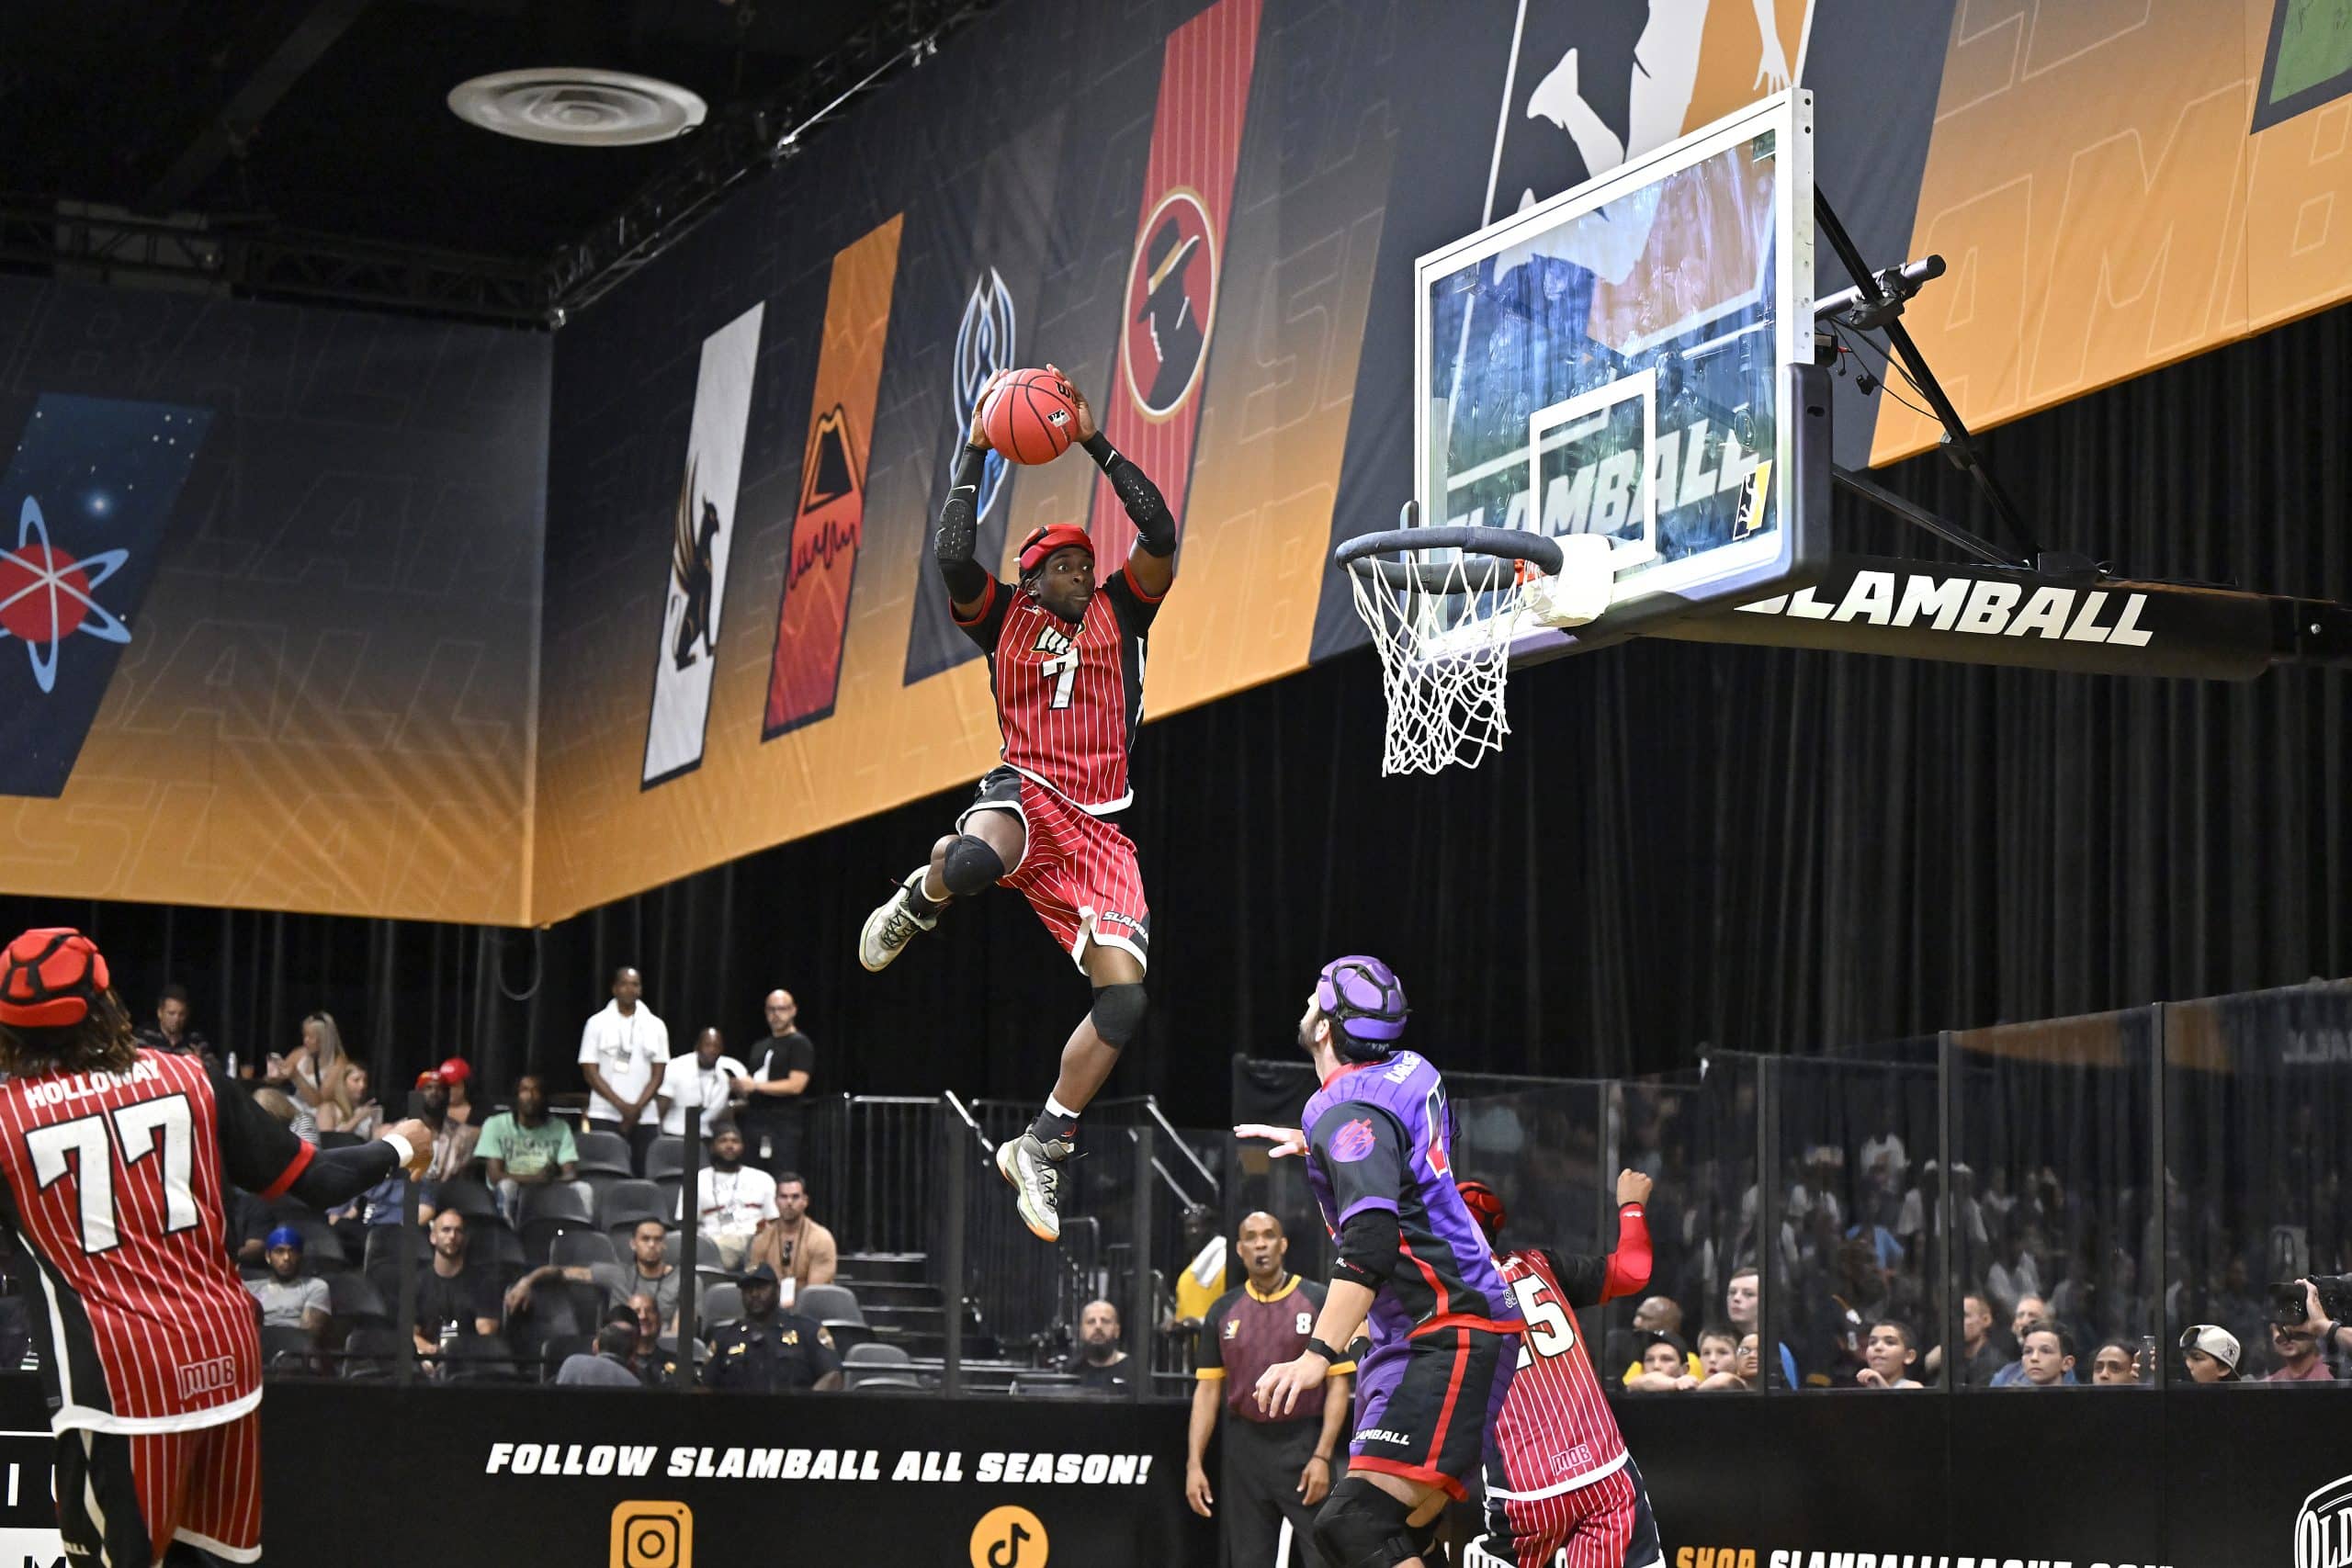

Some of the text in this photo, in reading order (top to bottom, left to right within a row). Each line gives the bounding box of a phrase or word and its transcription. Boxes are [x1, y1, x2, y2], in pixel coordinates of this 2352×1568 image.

[1042, 646, 1080, 710] 7
[24, 1059, 161, 1110] HOLLOWAY
[25, 1093, 199, 1256] 77
[1295, 1312, 1312, 1335] 8
[179, 1355, 237, 1400] MOB
[486, 1443, 1153, 1485] FOLLOW SLAMBALL ALL SEASON!
[1551, 1443, 1593, 1477] MOB
